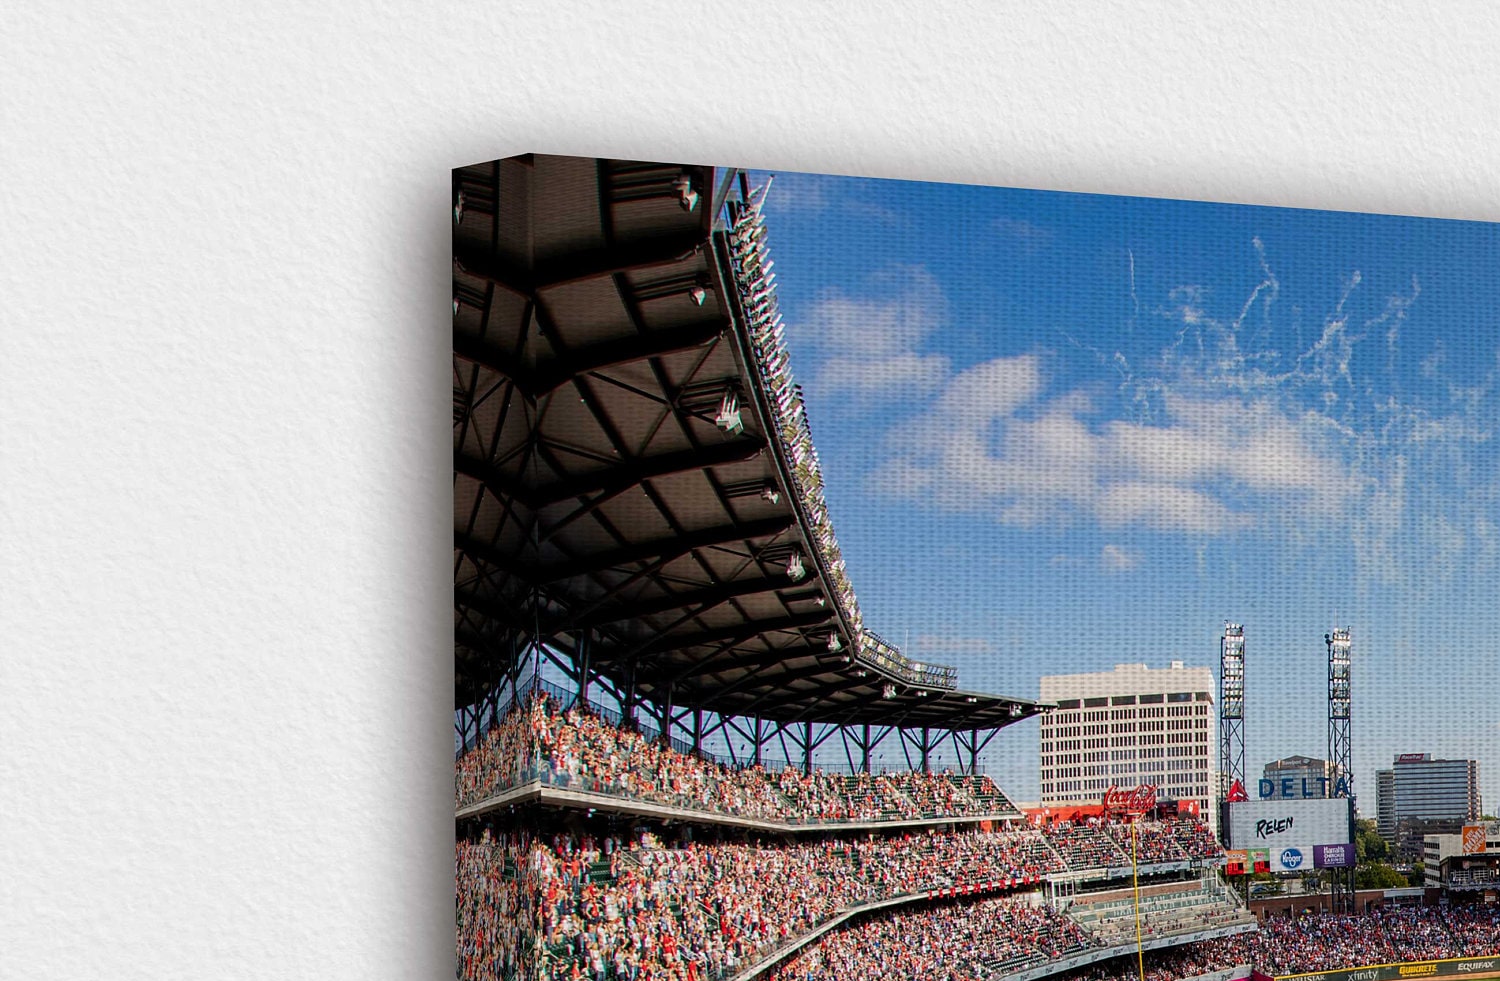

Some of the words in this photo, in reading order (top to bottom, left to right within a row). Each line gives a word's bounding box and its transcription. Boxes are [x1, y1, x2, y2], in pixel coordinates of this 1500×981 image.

[1258, 777, 1351, 798] DELTA
[1282, 851, 1302, 868] Kroger
[1457, 961, 1495, 972] EQUIFAX
